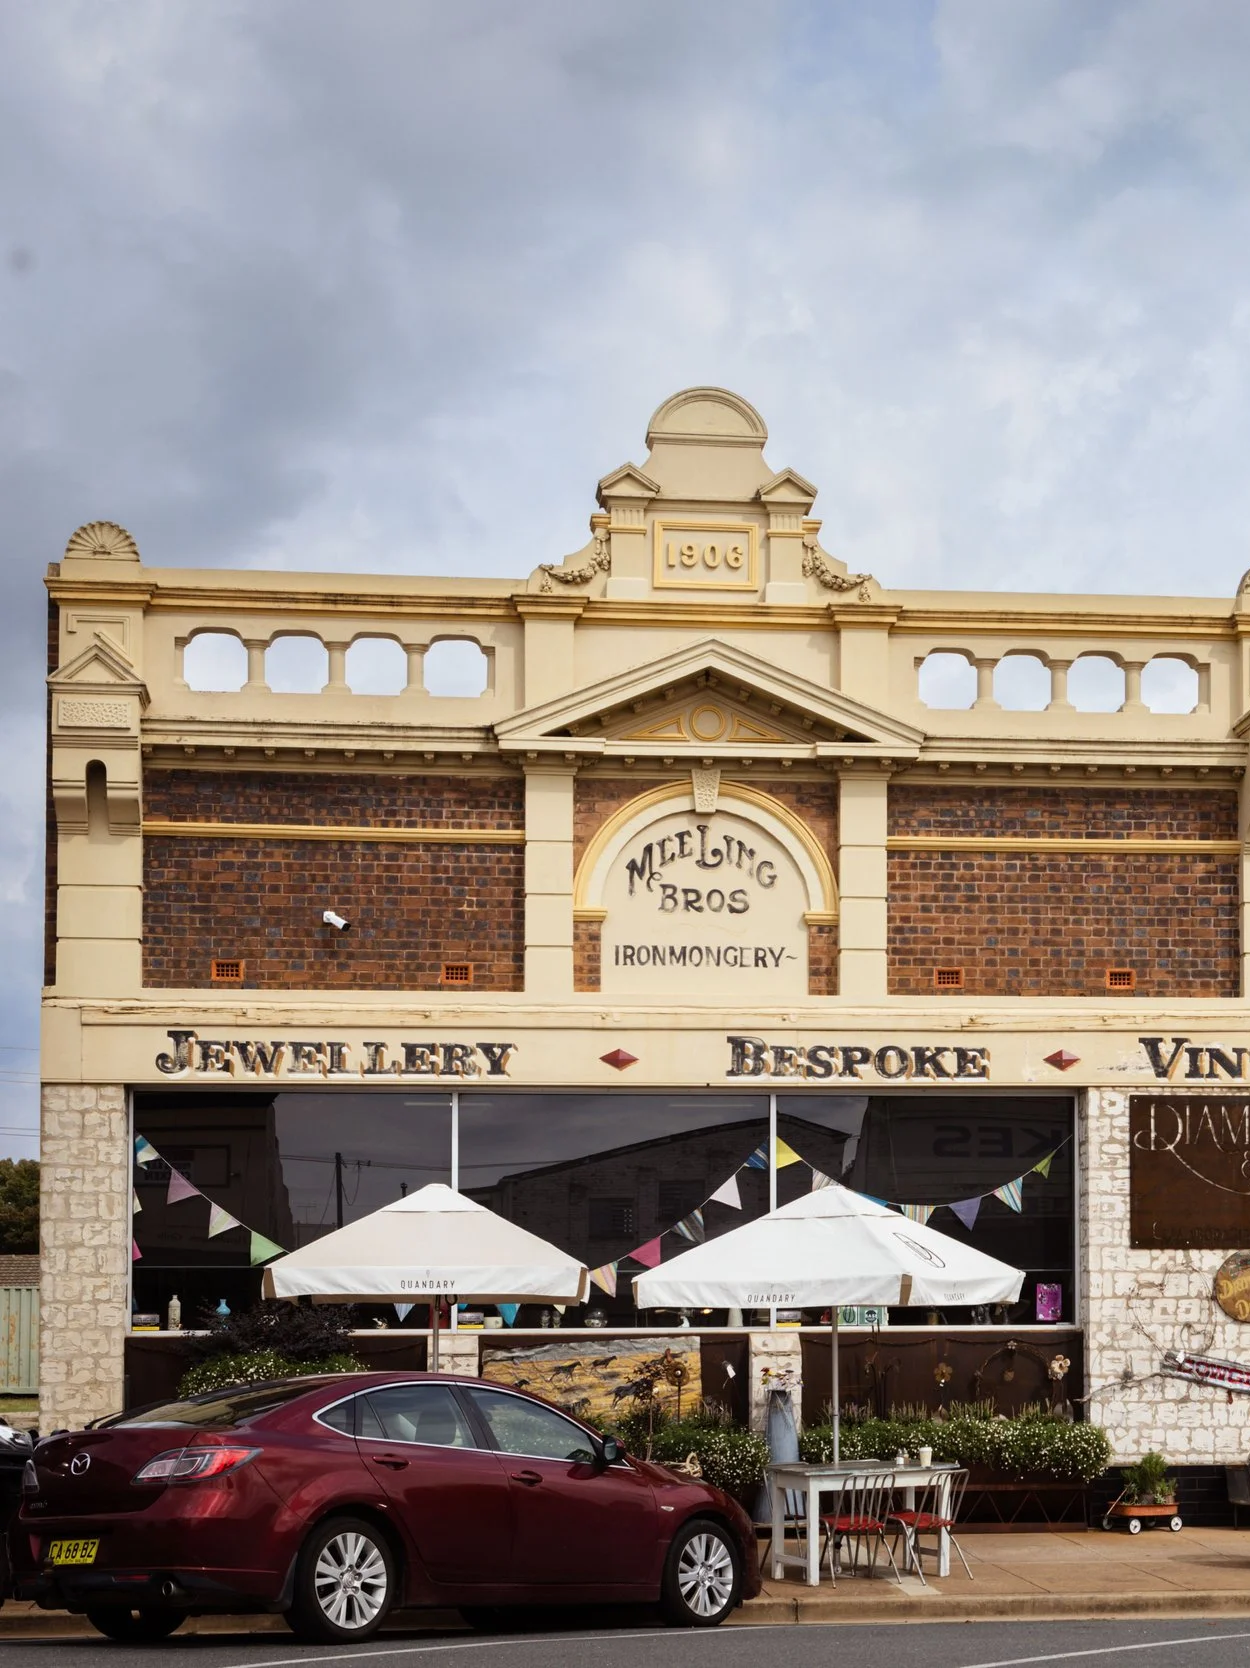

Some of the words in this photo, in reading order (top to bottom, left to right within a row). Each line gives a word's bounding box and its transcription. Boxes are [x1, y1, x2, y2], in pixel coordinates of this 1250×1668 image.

[667, 543, 744, 568] 1906
[659, 883, 750, 914] BROS
[156, 1030, 517, 1079] JEWELLERY
[726, 1036, 991, 1080] BESPOKE
[400, 1279, 456, 1290] QUANDARY
[747, 1292, 796, 1303] QUANDARY
